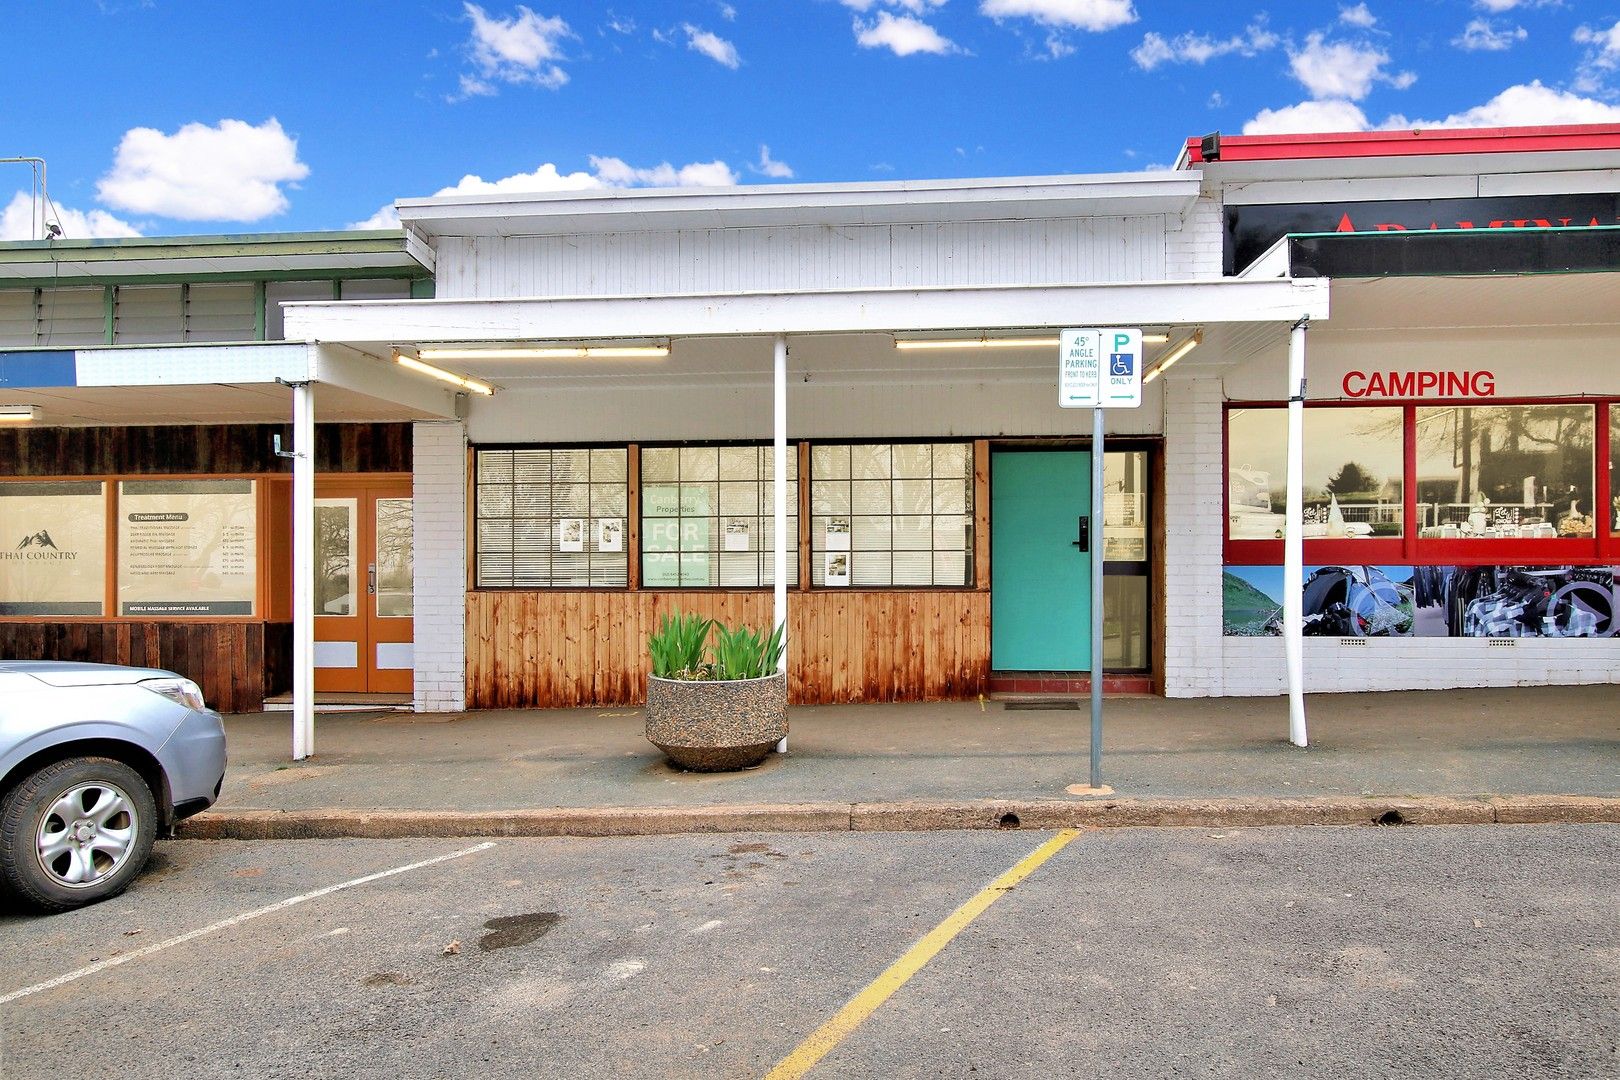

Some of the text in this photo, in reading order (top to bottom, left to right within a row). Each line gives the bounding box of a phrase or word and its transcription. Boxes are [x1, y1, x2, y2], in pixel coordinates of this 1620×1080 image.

[1114, 333, 1130, 352] P
[1069, 348, 1094, 358] ANGLE
[1065, 359, 1097, 369] PARKING
[1110, 377, 1133, 385] ONLY
[1342, 370, 1495, 398] CAMPING
[652, 522, 699, 541] FOR
[26, 551, 78, 560] COUNTRY
[647, 544, 705, 562] SALE
